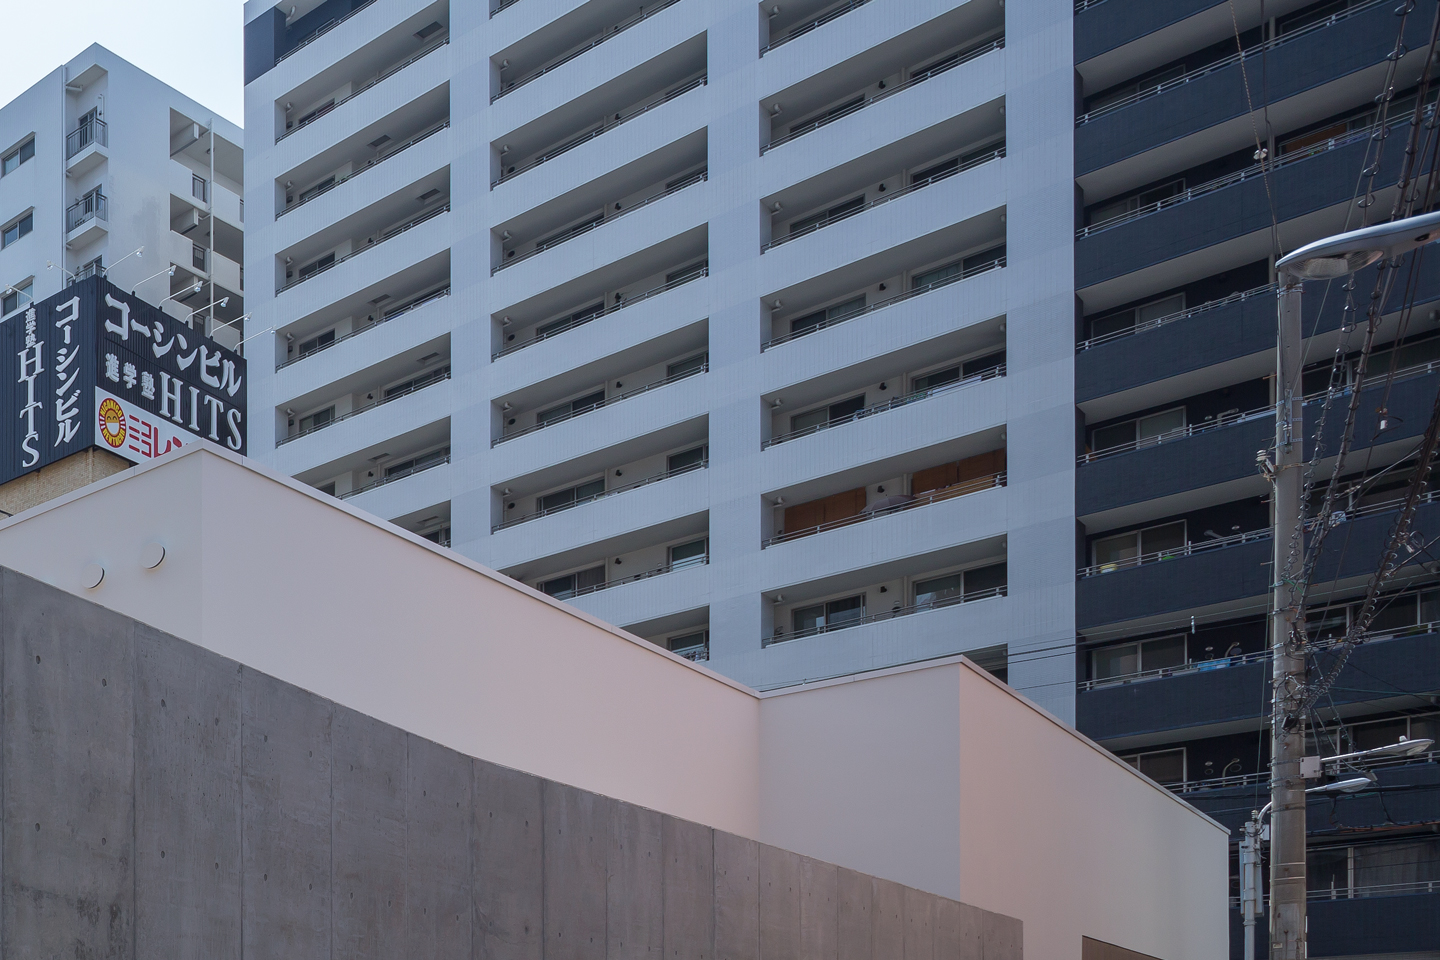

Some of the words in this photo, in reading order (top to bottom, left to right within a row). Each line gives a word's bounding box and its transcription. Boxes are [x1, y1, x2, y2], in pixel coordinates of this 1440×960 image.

[54, 295, 81, 447] コーシンビル
[105, 292, 242, 397] コーシンビル
[17, 340, 45, 468] HITS
[159, 371, 242, 450] HITS
